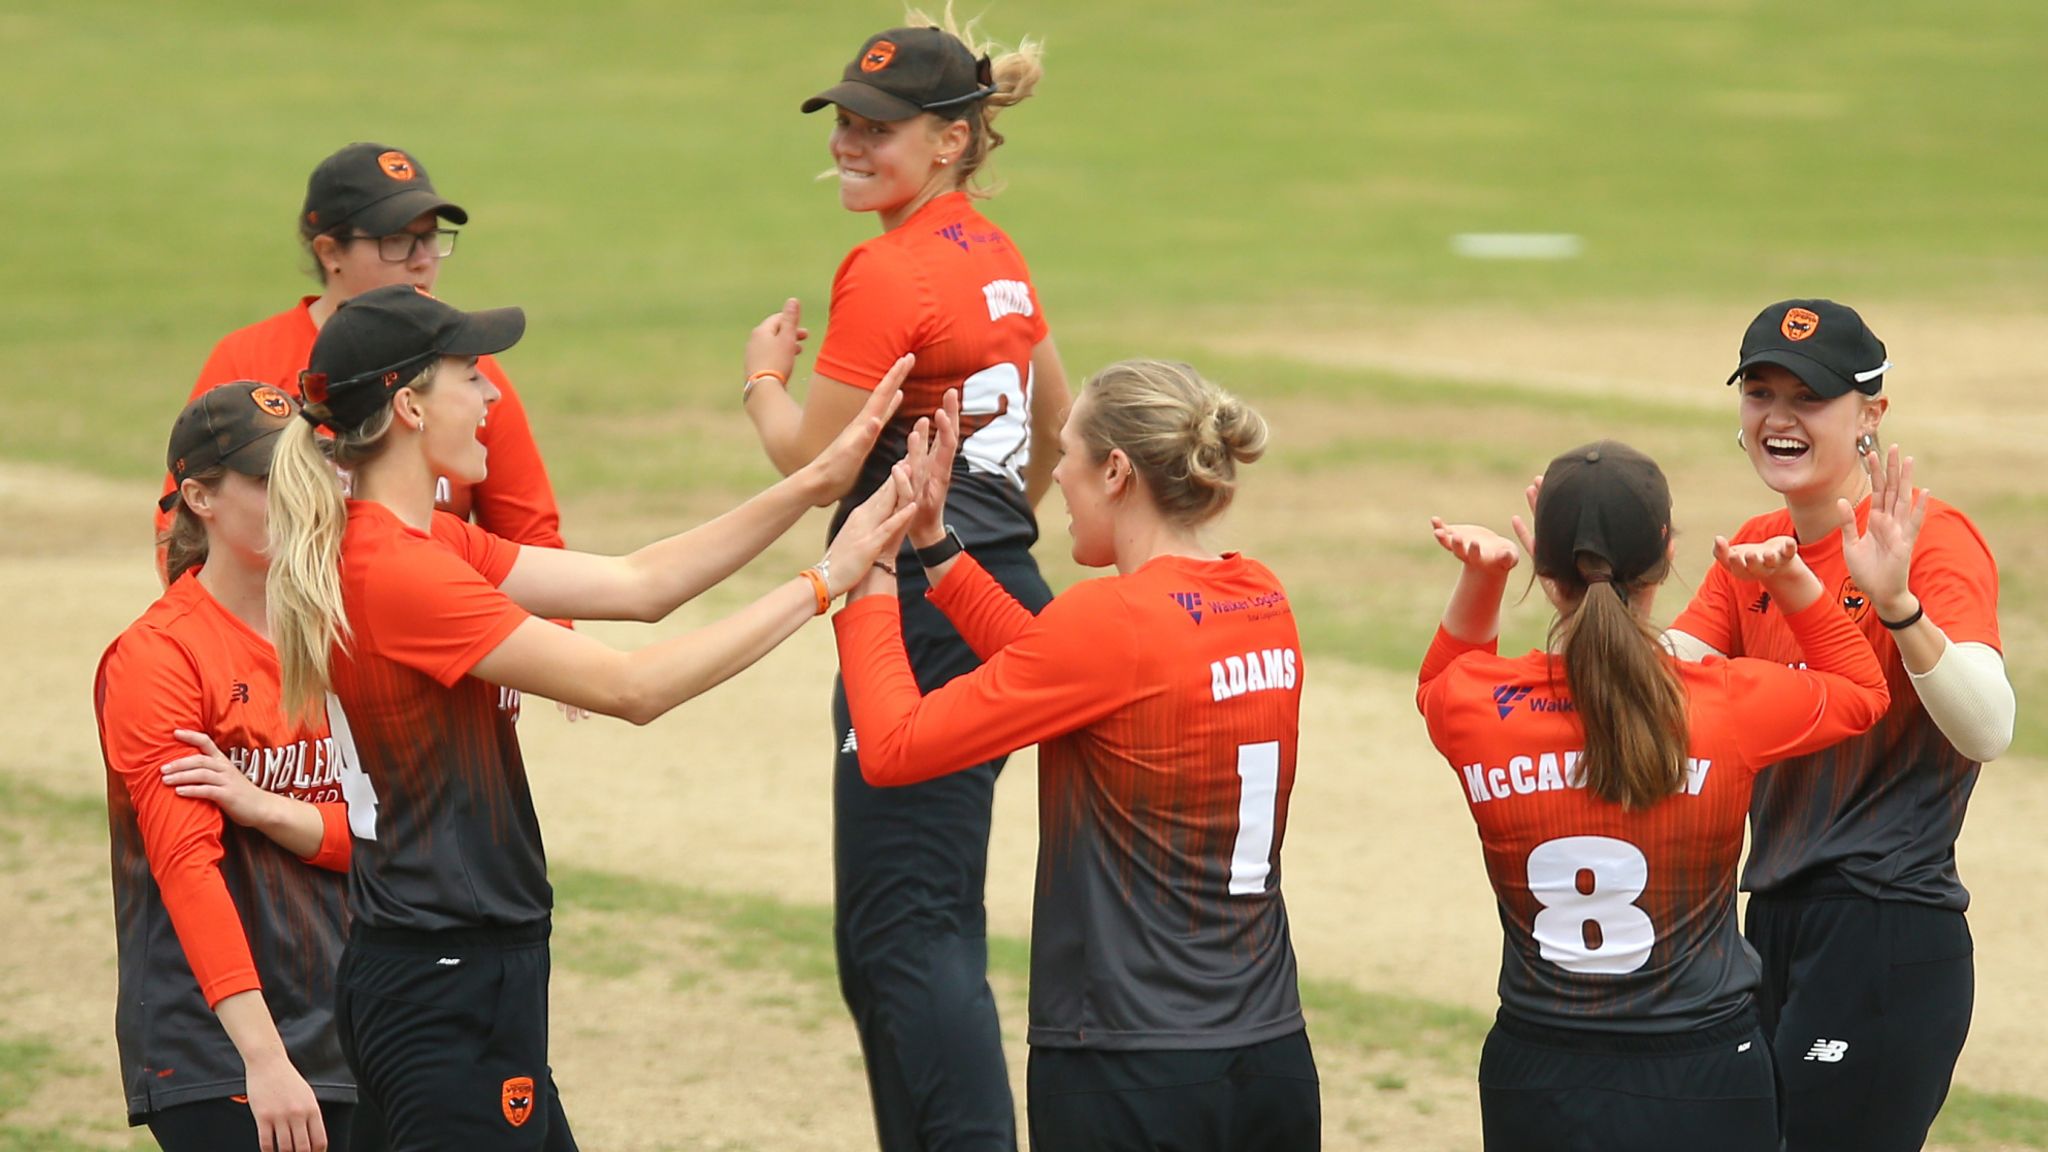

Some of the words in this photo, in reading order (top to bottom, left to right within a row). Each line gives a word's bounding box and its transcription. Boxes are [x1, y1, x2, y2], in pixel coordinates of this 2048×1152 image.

[960, 361, 1033, 491] 2
[1210, 648, 1297, 702] ADAMS
[1530, 697, 1574, 713] Walk
[1228, 740, 1280, 896] 1
[1526, 834, 1656, 975] 8
